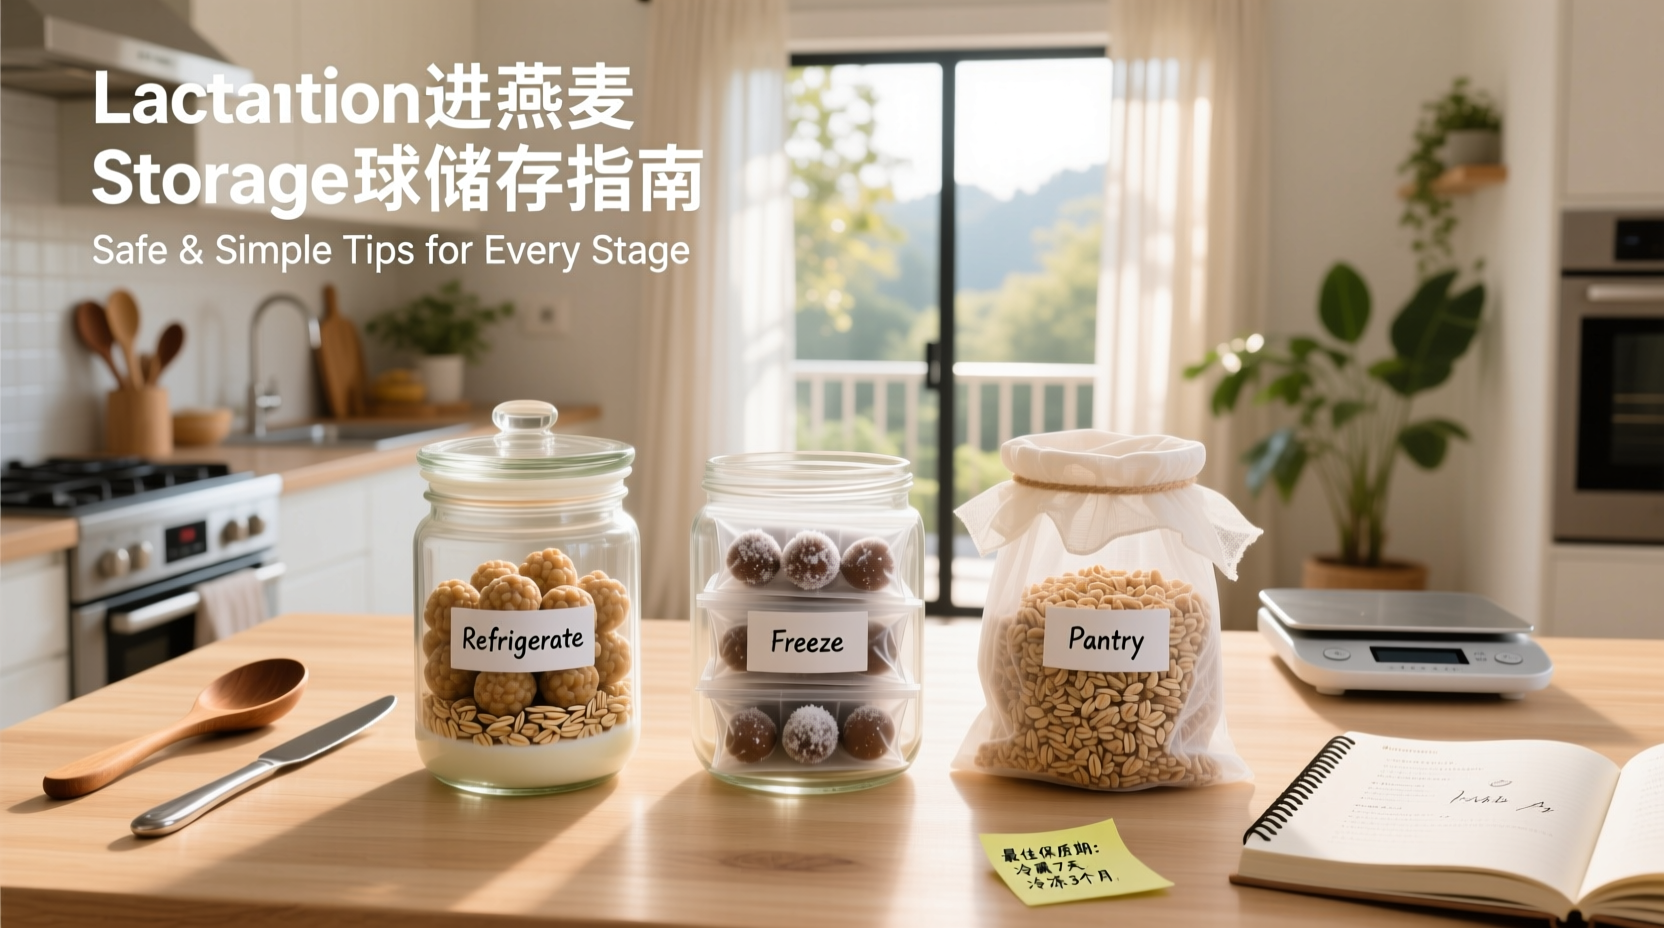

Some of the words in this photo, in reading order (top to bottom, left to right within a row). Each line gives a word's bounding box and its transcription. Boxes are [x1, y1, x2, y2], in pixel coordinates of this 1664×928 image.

[462, 626, 584, 660] Refrigerate
[771, 628, 844, 653] Freeze
[1068, 625, 1145, 661] Pantry
